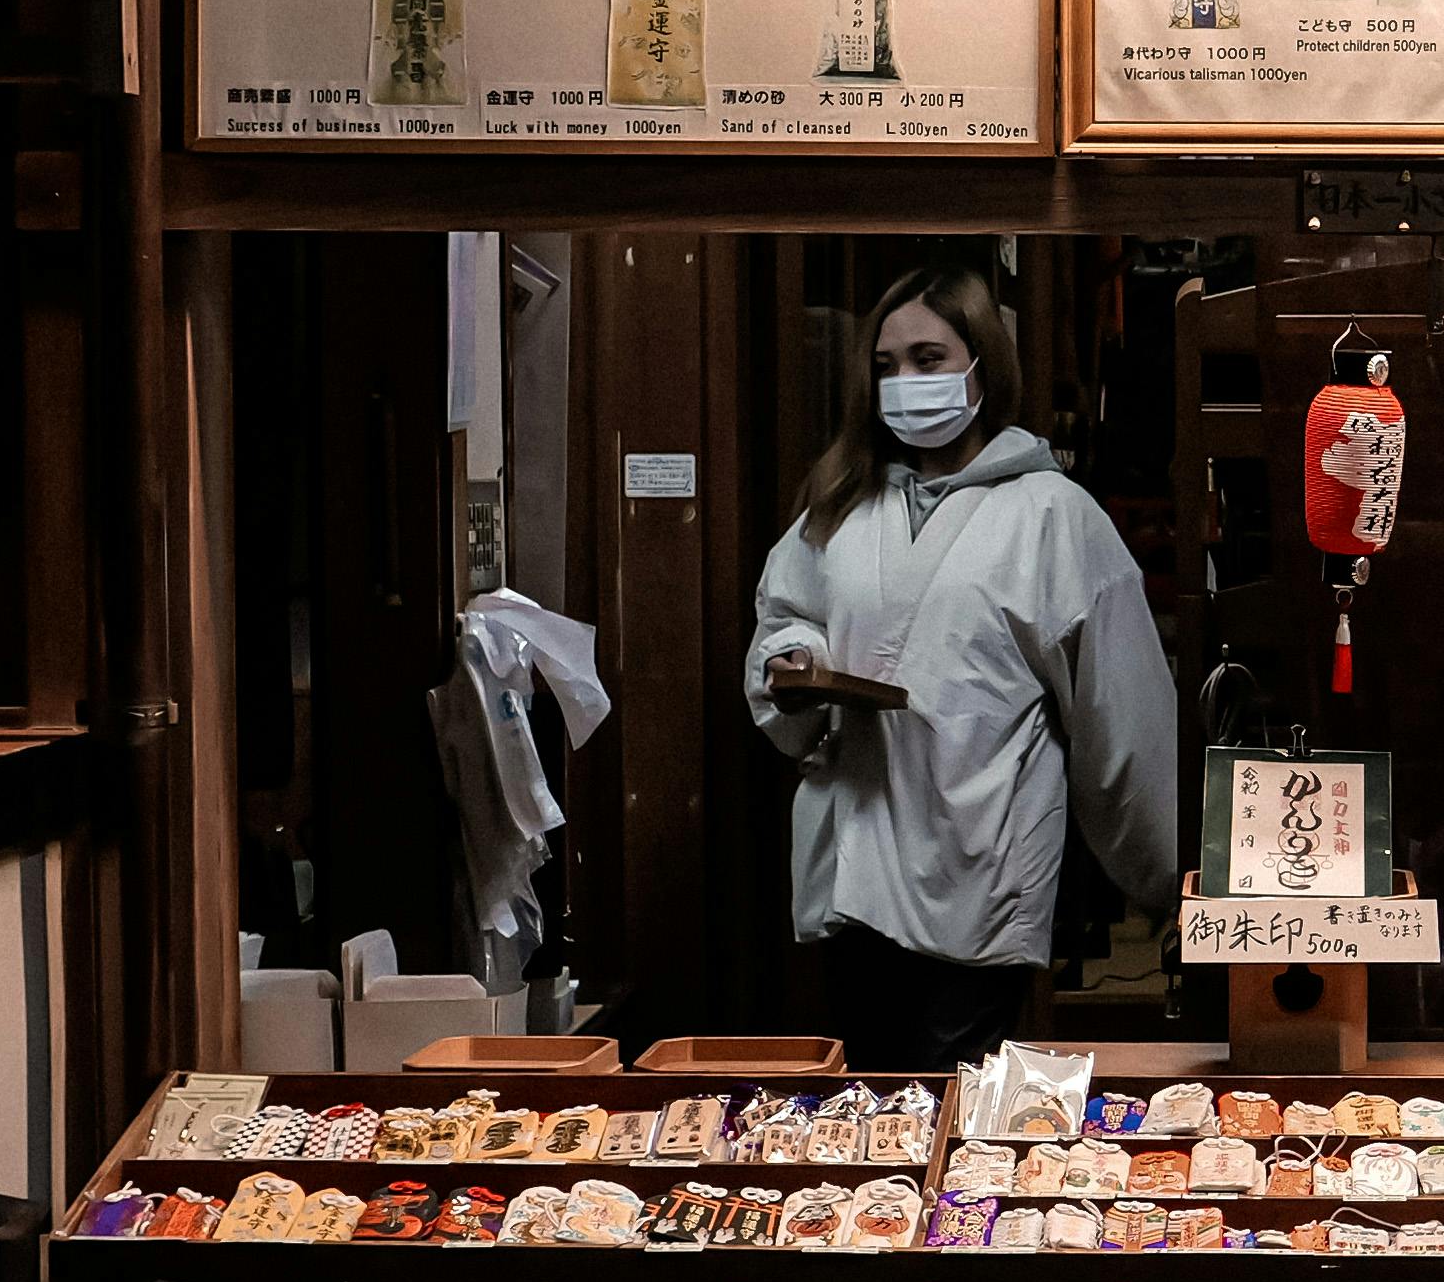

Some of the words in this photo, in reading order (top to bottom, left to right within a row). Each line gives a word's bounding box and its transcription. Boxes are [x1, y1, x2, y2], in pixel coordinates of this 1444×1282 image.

[1298, 20, 1351, 33] こども守
[1123, 47, 1191, 60] 身代わり守
[1296, 40, 1339, 53] Protect
[1343, 40, 1389, 53] children
[1393, 40, 1436, 54] 500yen
[1124, 69, 1185, 81] Vicarious
[1190, 69, 1245, 81] talisman
[1250, 69, 1307, 83] 1000yen
[486, 91, 534, 106] 金運守
[722, 91, 785, 105] 清めの砂
[228, 119, 282, 133] Success
[292, 119, 309, 132] of
[316, 119, 380, 133] business
[397, 119, 454, 135] 1000yen
[486, 121, 516, 134] Luck
[526, 121, 558, 134] with
[567, 122, 607, 136] money
[625, 121, 682, 135] 1000yen
[721, 119, 752, 133] Sand
[761, 120, 778, 134] of
[786, 120, 850, 135] cleansed
[1186, 909, 1304, 954] 御朱印
